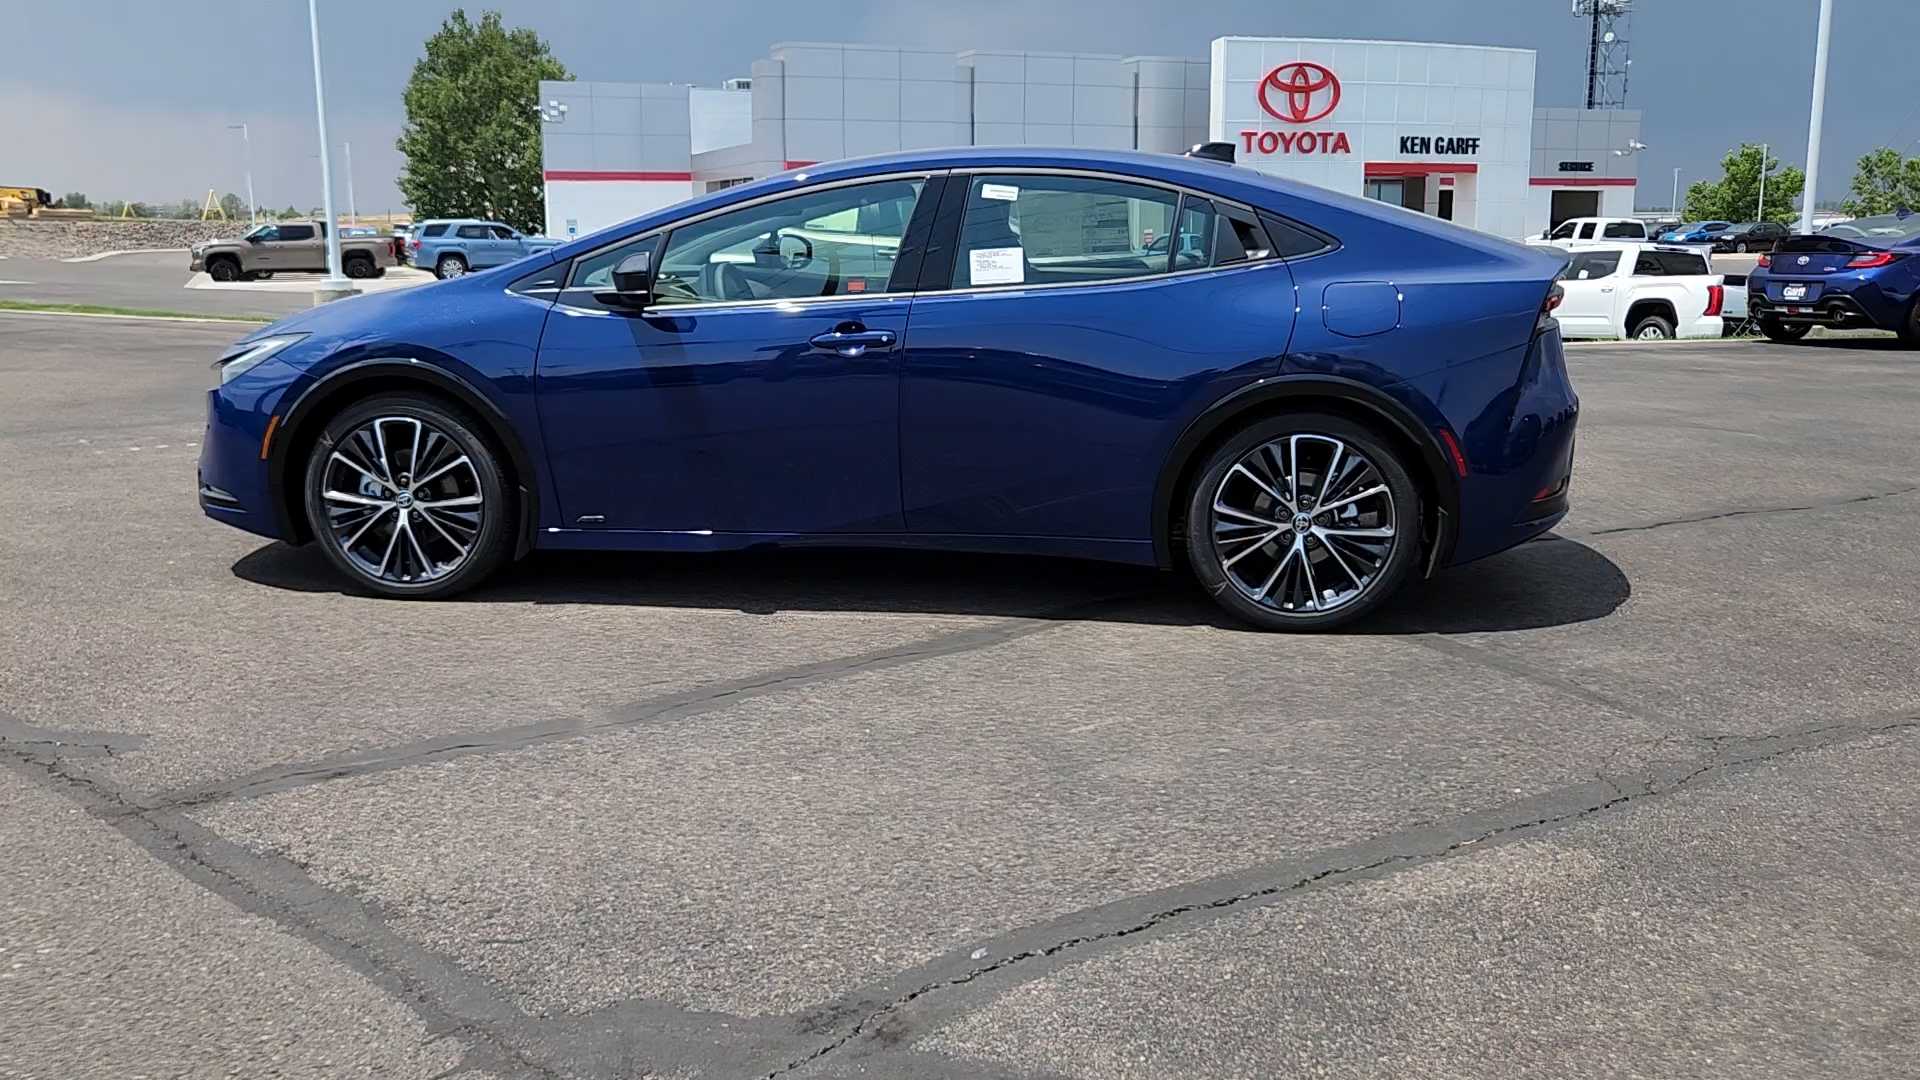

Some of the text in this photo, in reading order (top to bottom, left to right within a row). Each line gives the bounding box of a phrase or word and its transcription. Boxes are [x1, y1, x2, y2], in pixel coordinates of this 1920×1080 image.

[1241, 131, 1351, 155] TOYOTA
[1400, 136, 1480, 155] KEN GARFF
